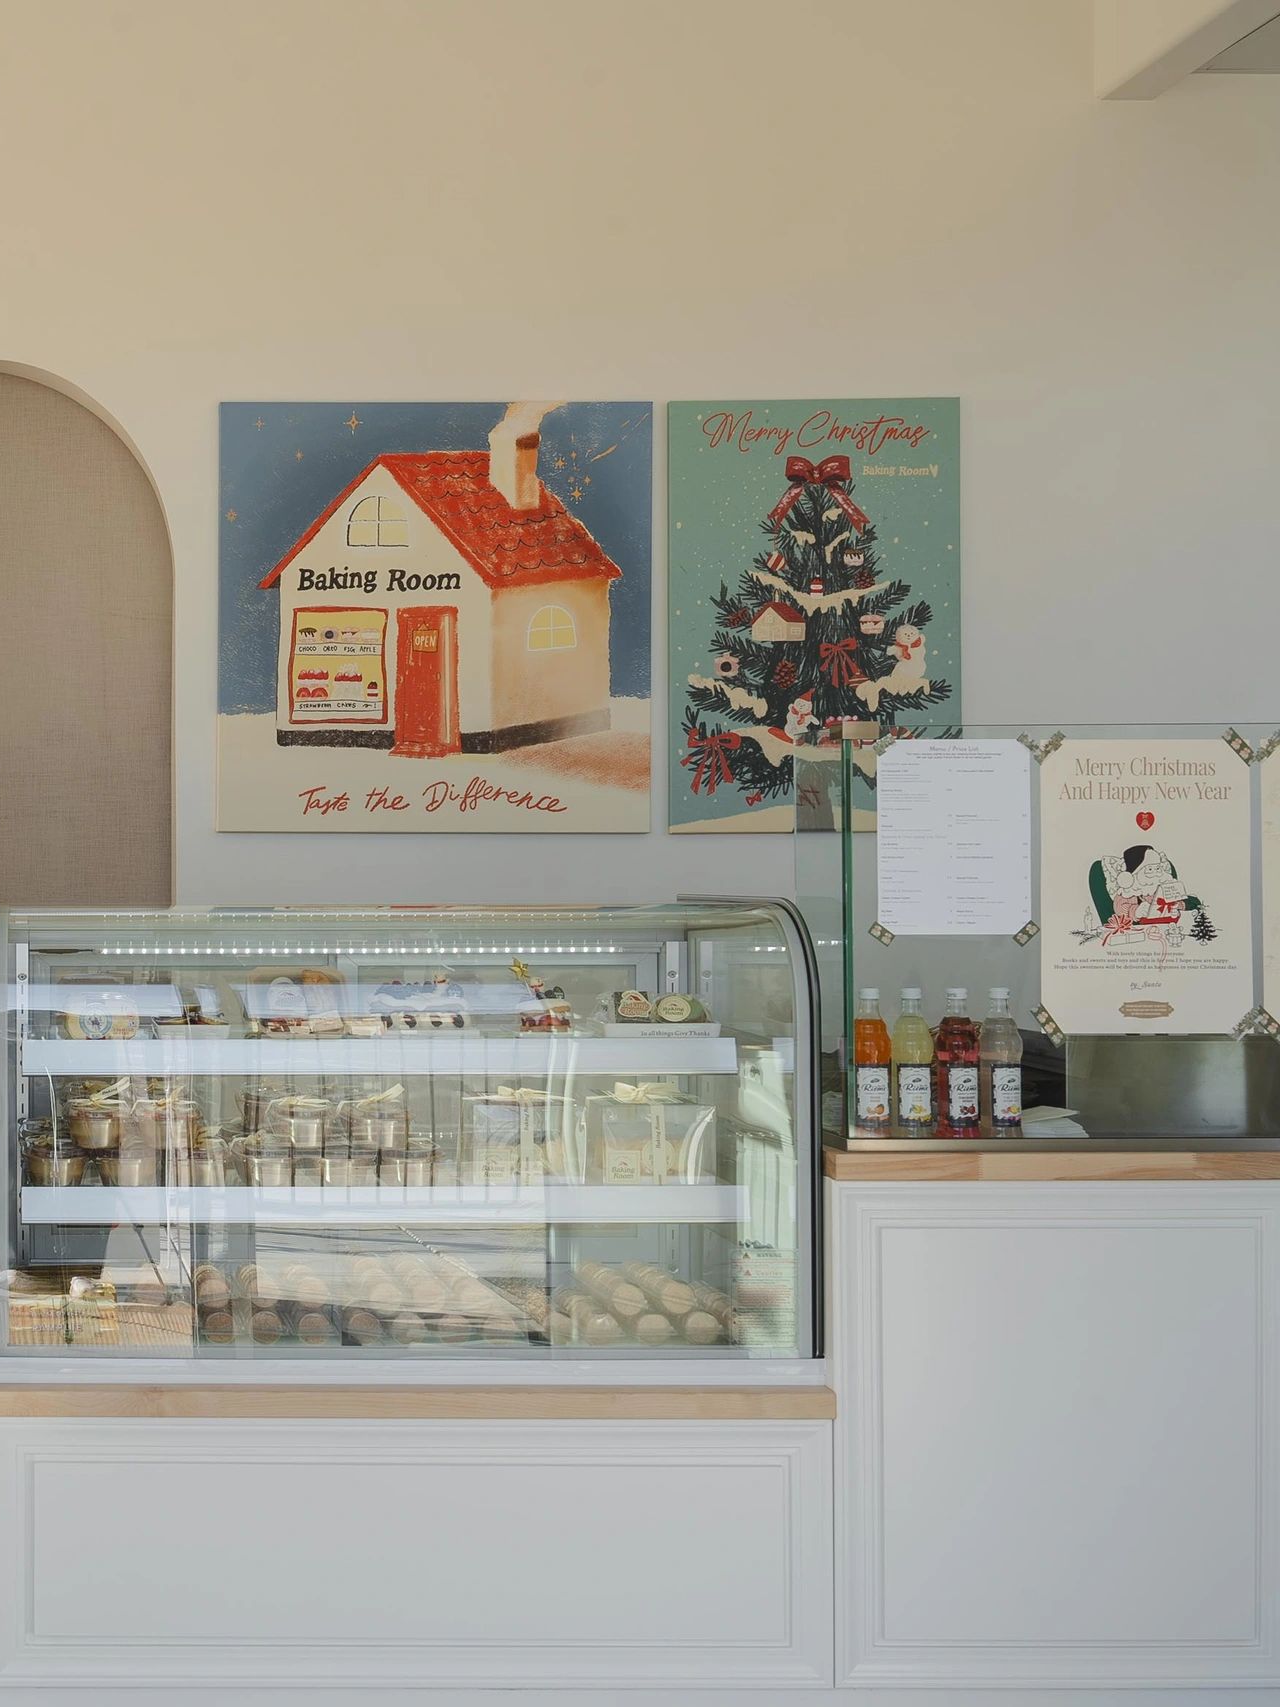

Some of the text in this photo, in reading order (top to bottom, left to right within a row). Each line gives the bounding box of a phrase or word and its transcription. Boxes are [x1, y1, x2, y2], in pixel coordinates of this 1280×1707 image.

[702, 410, 931, 455] Merry Christmas
[862, 464, 930, 476] Baking Room
[297, 566, 461, 593] Baking Room
[360, 645, 376, 653] APPLE
[414, 635, 437, 647] OPEN
[1075, 757, 1216, 780] Merry Christmas
[299, 777, 567, 815] Taste the Difference
[1059, 781, 1232, 804] And Happy New Year
